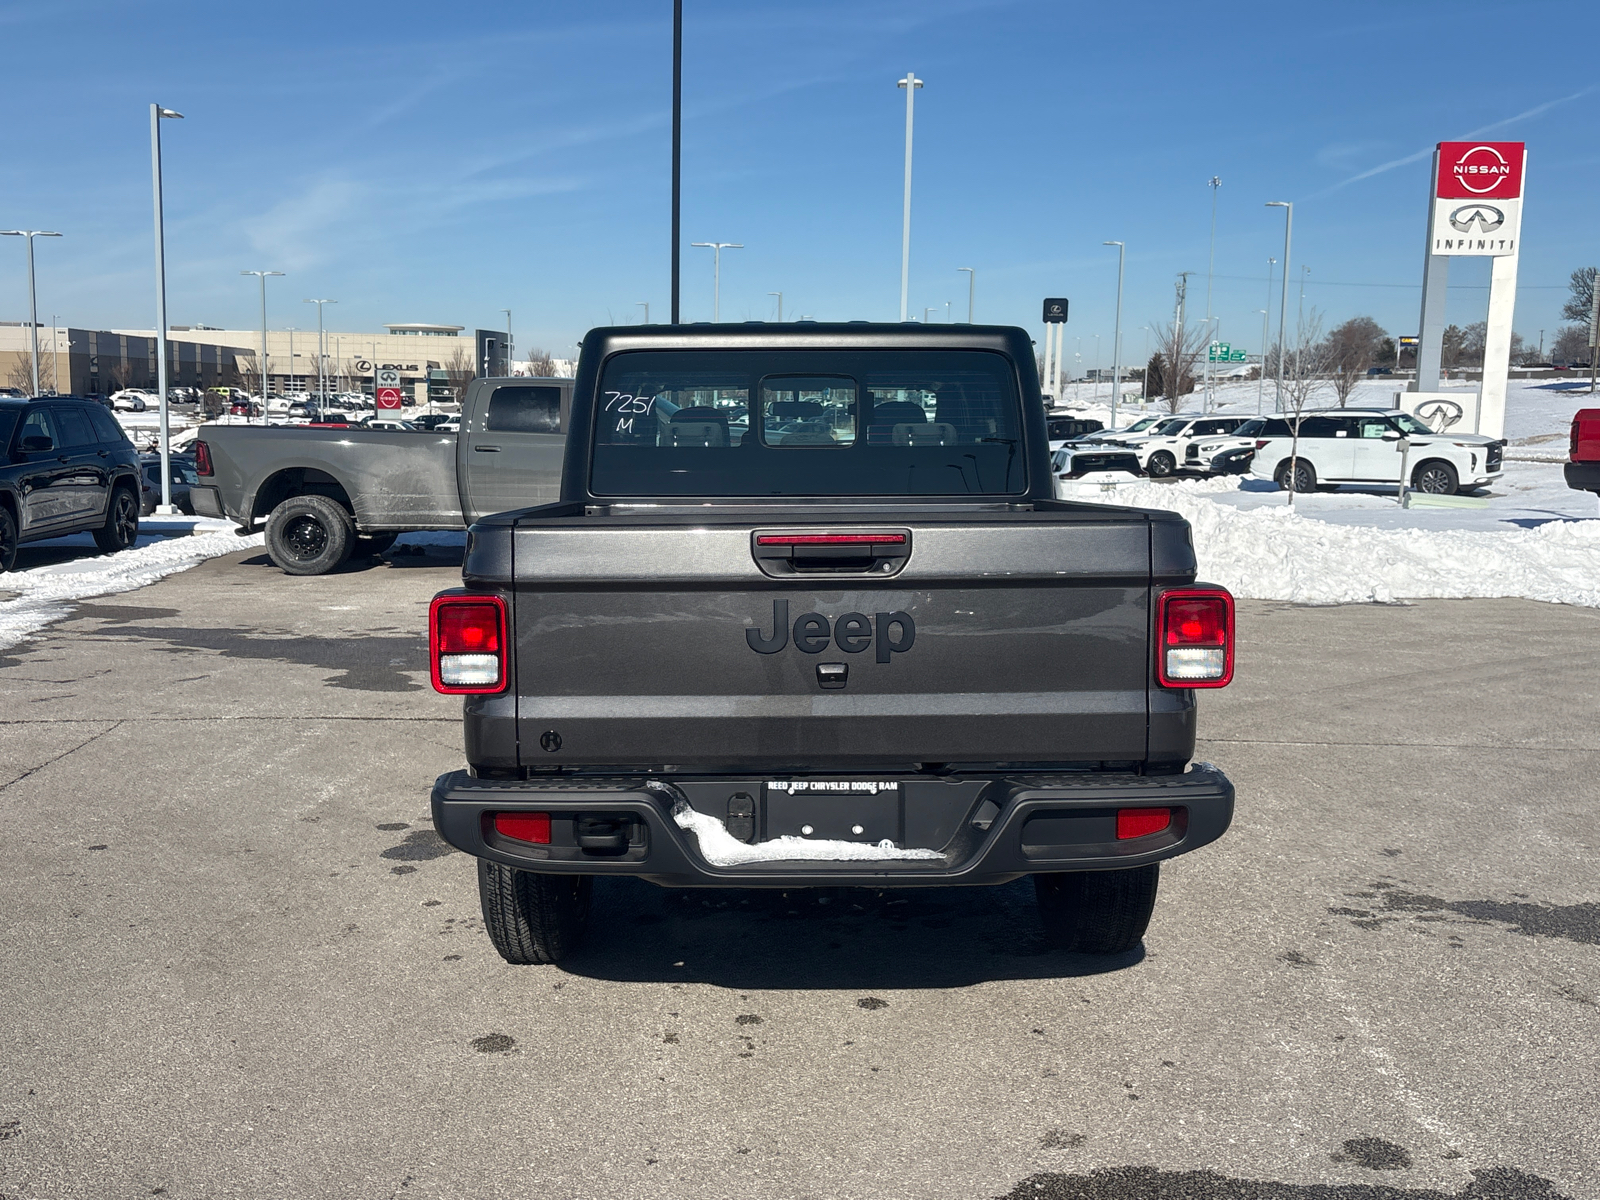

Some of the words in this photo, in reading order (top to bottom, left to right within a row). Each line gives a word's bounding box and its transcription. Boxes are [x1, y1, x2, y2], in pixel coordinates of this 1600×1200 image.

[1453, 165, 1510, 174] NISSAN
[1436, 239, 1514, 250] INFINITI
[374, 363, 419, 371] LEXUS
[604, 391, 656, 416] 7251
[615, 417, 634, 434] M
[745, 599, 916, 664] Jeep
[768, 781, 788, 790] REED
[790, 781, 809, 790] JEEP
[810, 781, 850, 790] CHRYSLER
[851, 781, 877, 790] DODGE
[879, 781, 898, 790] RAM
